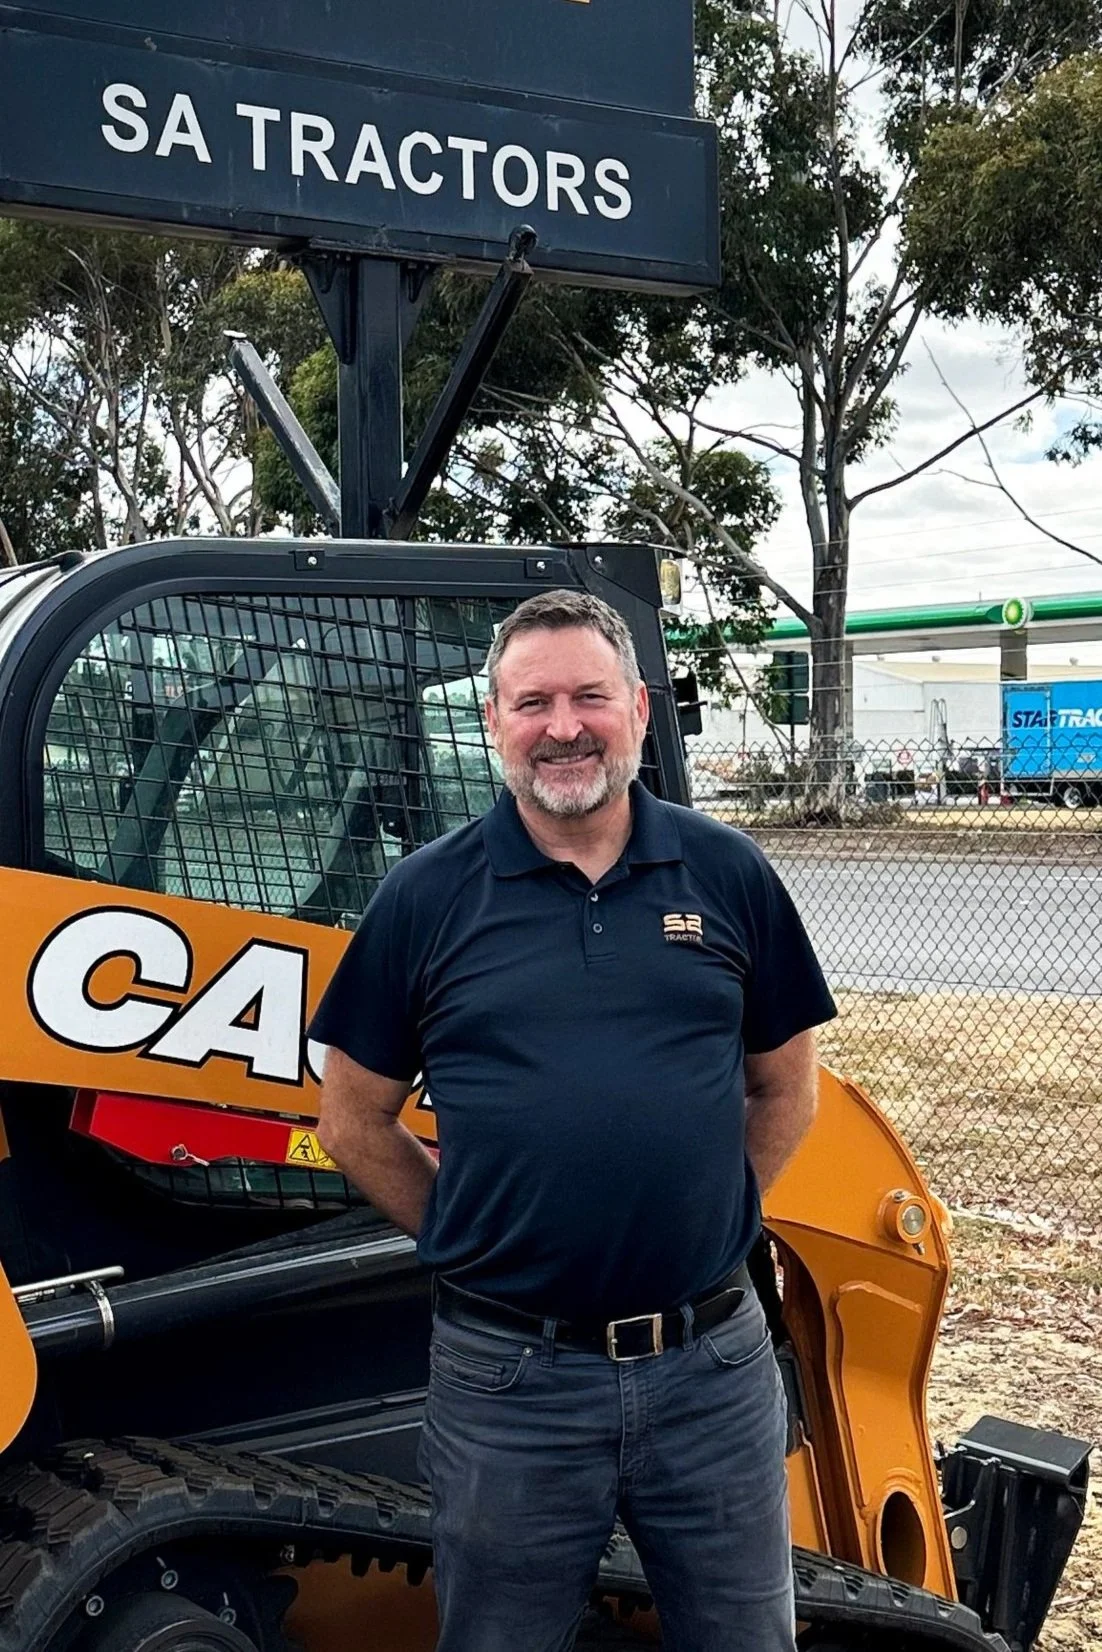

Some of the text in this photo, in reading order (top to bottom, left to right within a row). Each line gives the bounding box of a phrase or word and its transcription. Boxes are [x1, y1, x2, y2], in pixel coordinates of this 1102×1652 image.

[101, 83, 633, 220] SA TRACTORS
[27, 905, 437, 1111] CA
